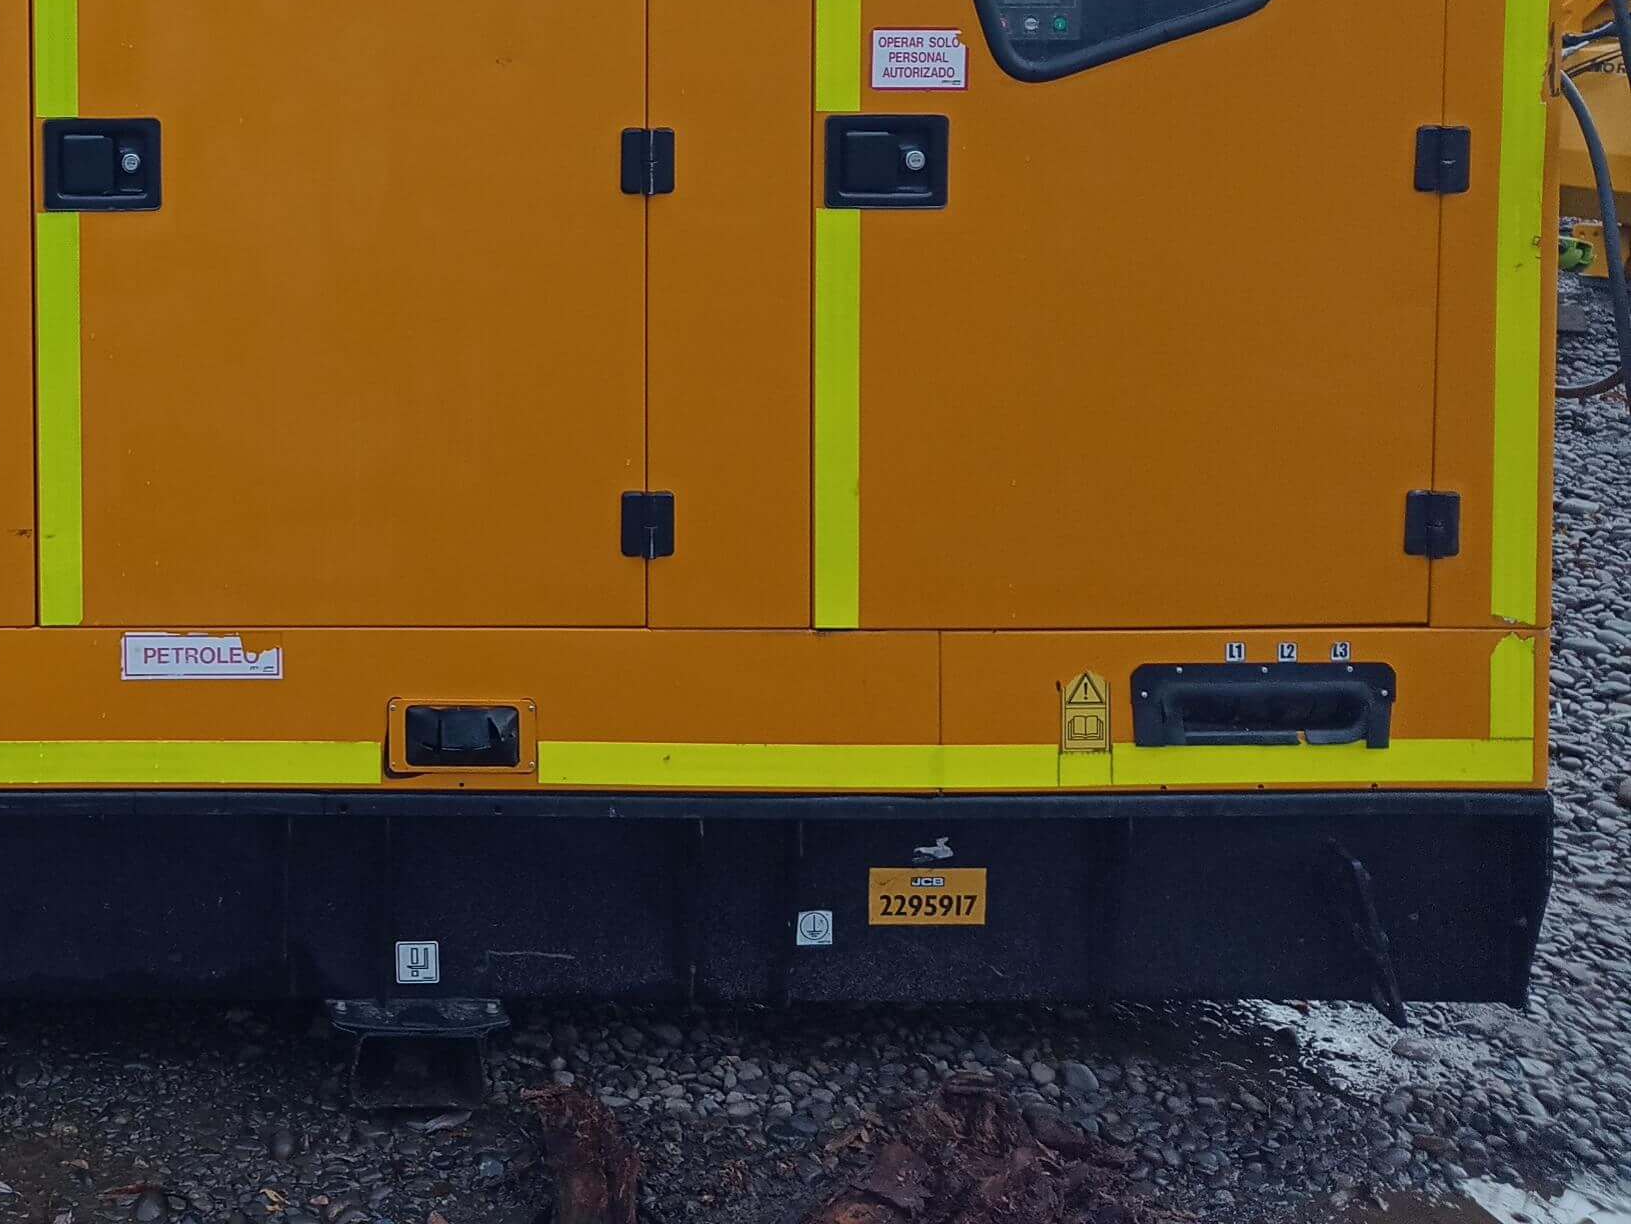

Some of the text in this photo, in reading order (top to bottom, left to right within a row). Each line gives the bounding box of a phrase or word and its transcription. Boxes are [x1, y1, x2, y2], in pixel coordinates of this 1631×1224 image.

[878, 36, 960, 48] OPERAR SOLO
[889, 52, 949, 63] PERSONAL
[882, 67, 955, 78] AUTORIZADO
[1228, 642, 1348, 660] L1 L2 L3
[911, 877, 944, 887] JCB
[879, 895, 977, 916] 2295917
